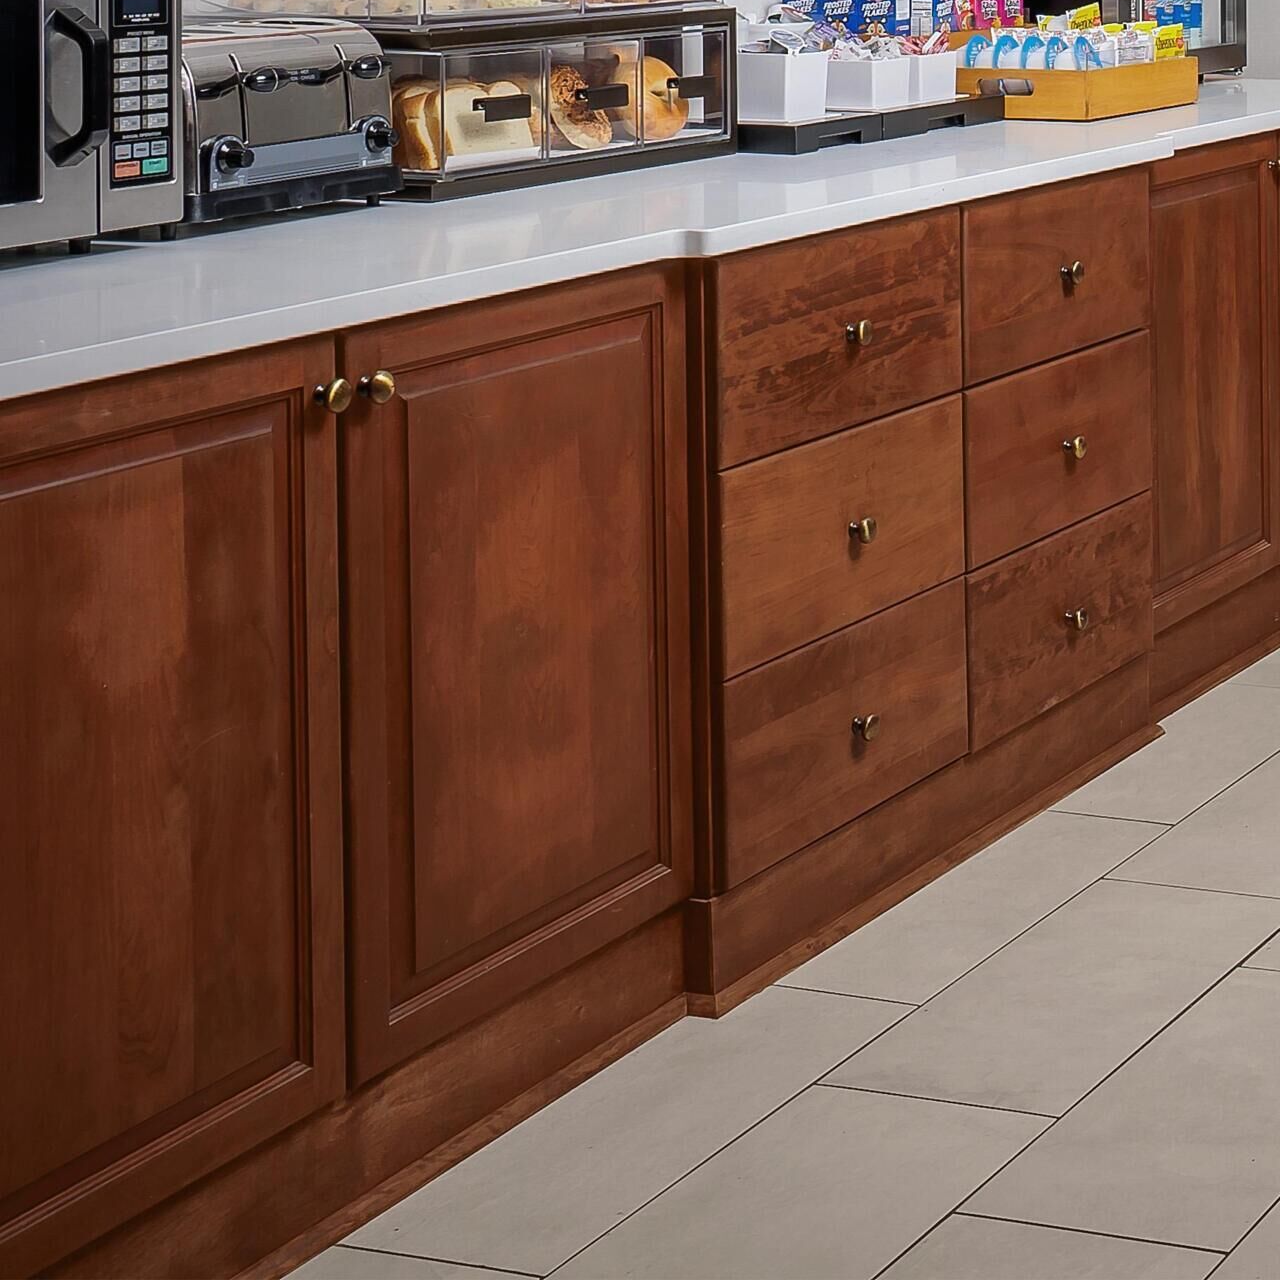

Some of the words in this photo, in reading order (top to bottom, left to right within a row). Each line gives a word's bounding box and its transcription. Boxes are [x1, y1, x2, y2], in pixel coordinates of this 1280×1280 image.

[823, 0, 853, 11] FROSTED
[825, 5, 850, 17] FLAKES
[861, 0, 891, 12] FROSTED
[863, 6, 889, 18] FLAKES
